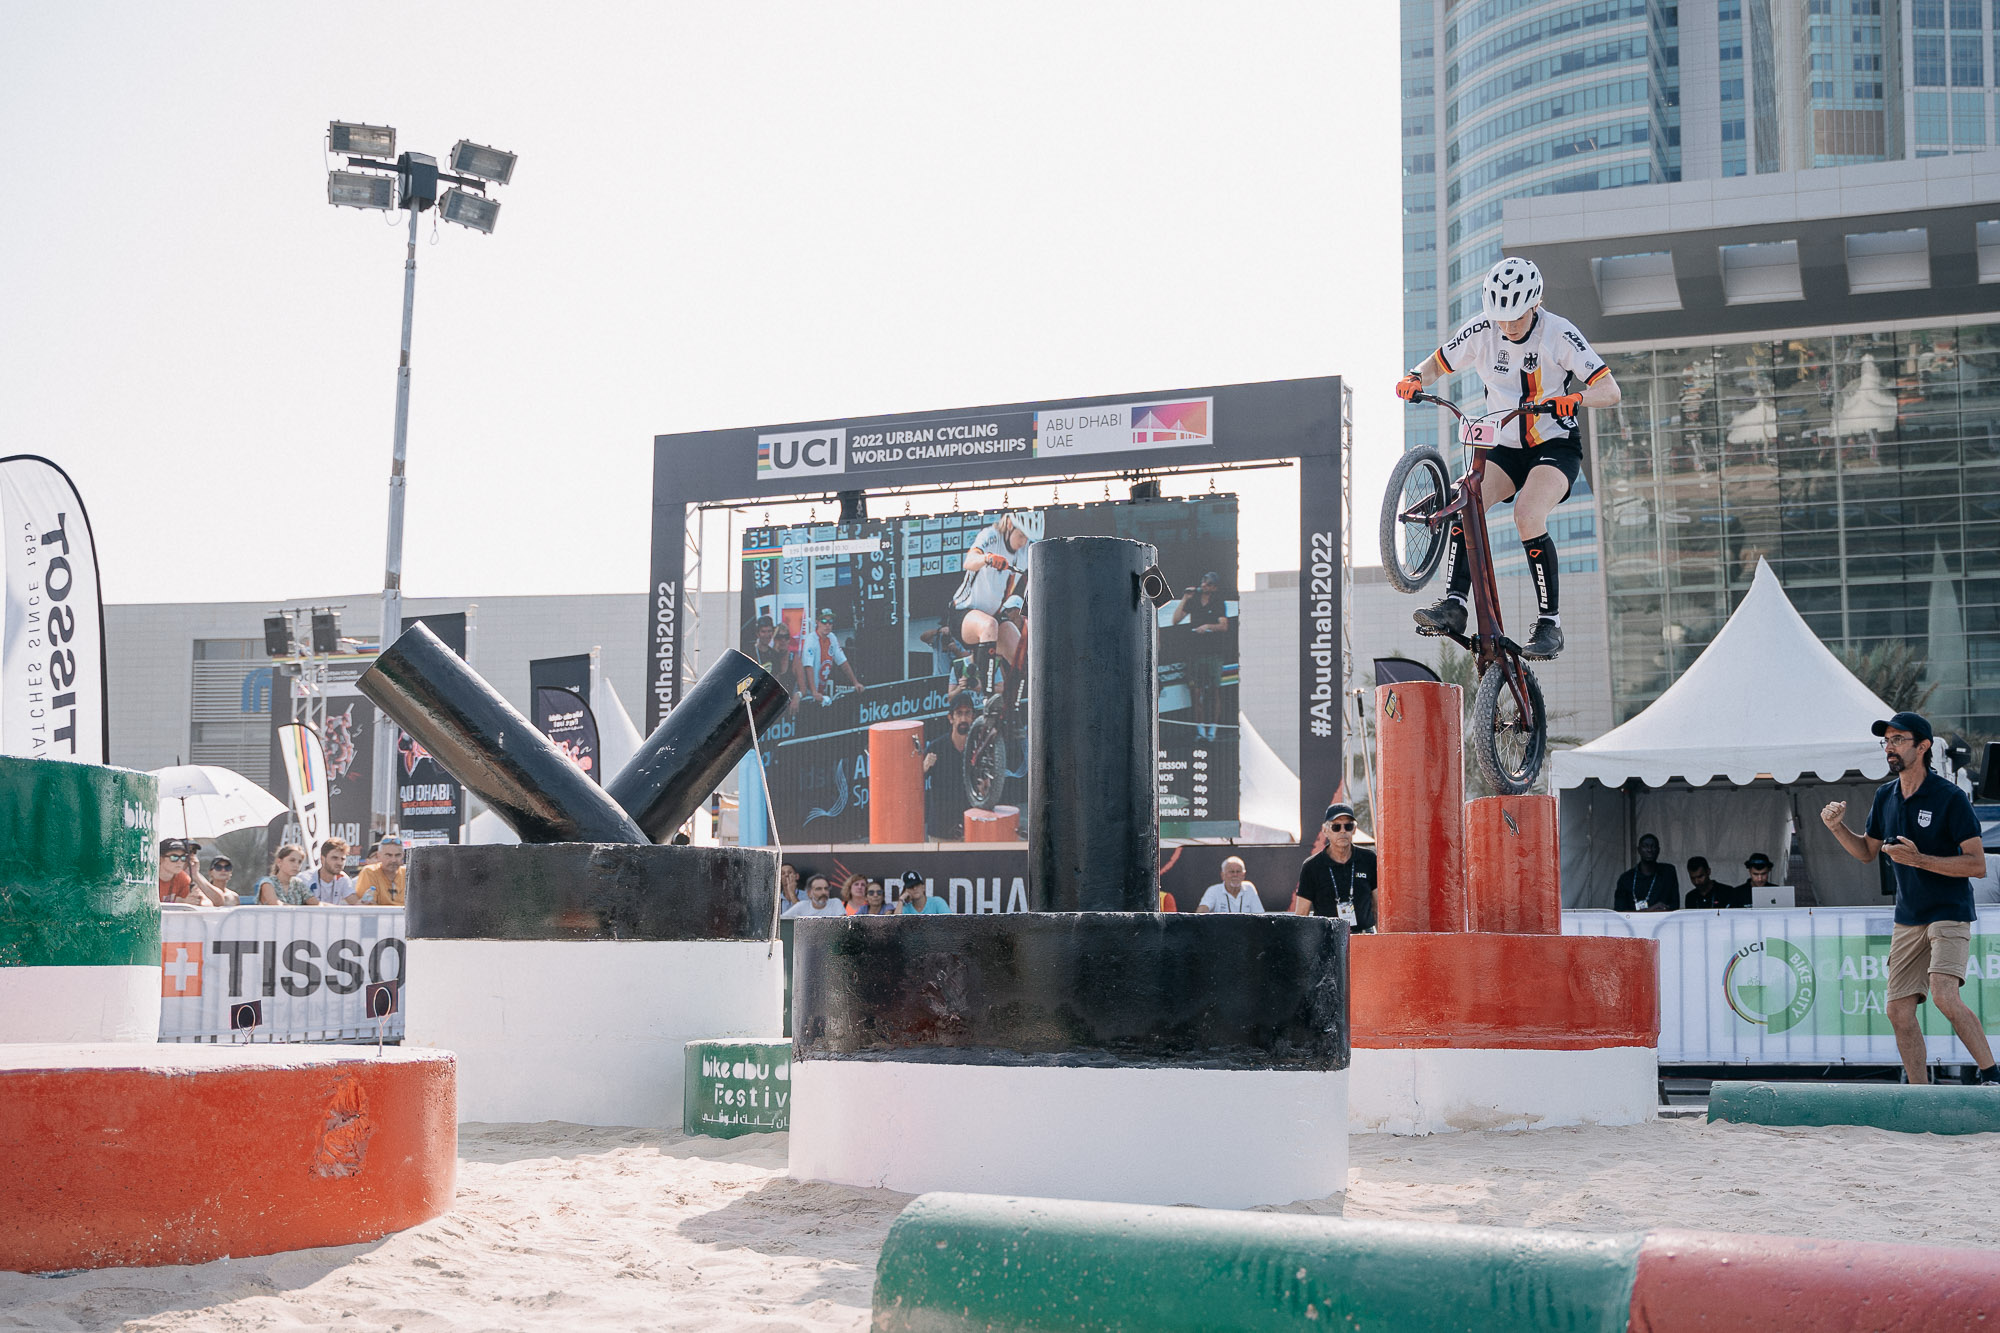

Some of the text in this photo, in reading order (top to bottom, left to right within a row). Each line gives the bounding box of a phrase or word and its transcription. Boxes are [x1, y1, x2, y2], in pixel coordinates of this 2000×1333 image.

[1564, 331, 1586, 352] KTM
[1046, 413, 1122, 432] ABU DHABI
[1474, 428, 1483, 441] 2
[852, 423, 999, 449] 2022 URBAN CYCLING
[1046, 434, 1074, 449] UAE
[772, 437, 838, 470] UCI
[852, 437, 1026, 465] WORLD CHAMPIONSHIPS
[946, 536, 960, 546] UCI
[925, 560, 940, 571] UCI
[1310, 532, 1332, 738] #Abudhabi2022
[655, 581, 676, 720] udhabi2022
[859, 701, 890, 724] bike
[892, 696, 920, 716] abu
[1158, 761, 1188, 770] ERSSON
[948, 877, 1028, 914] DHA
[1738, 942, 1764, 958] UCI
[1788, 952, 1812, 1018] BIKE CITY
[702, 1054, 730, 1078] bike
[732, 1055, 770, 1080] abu
[714, 1083, 788, 1108] Festiv
